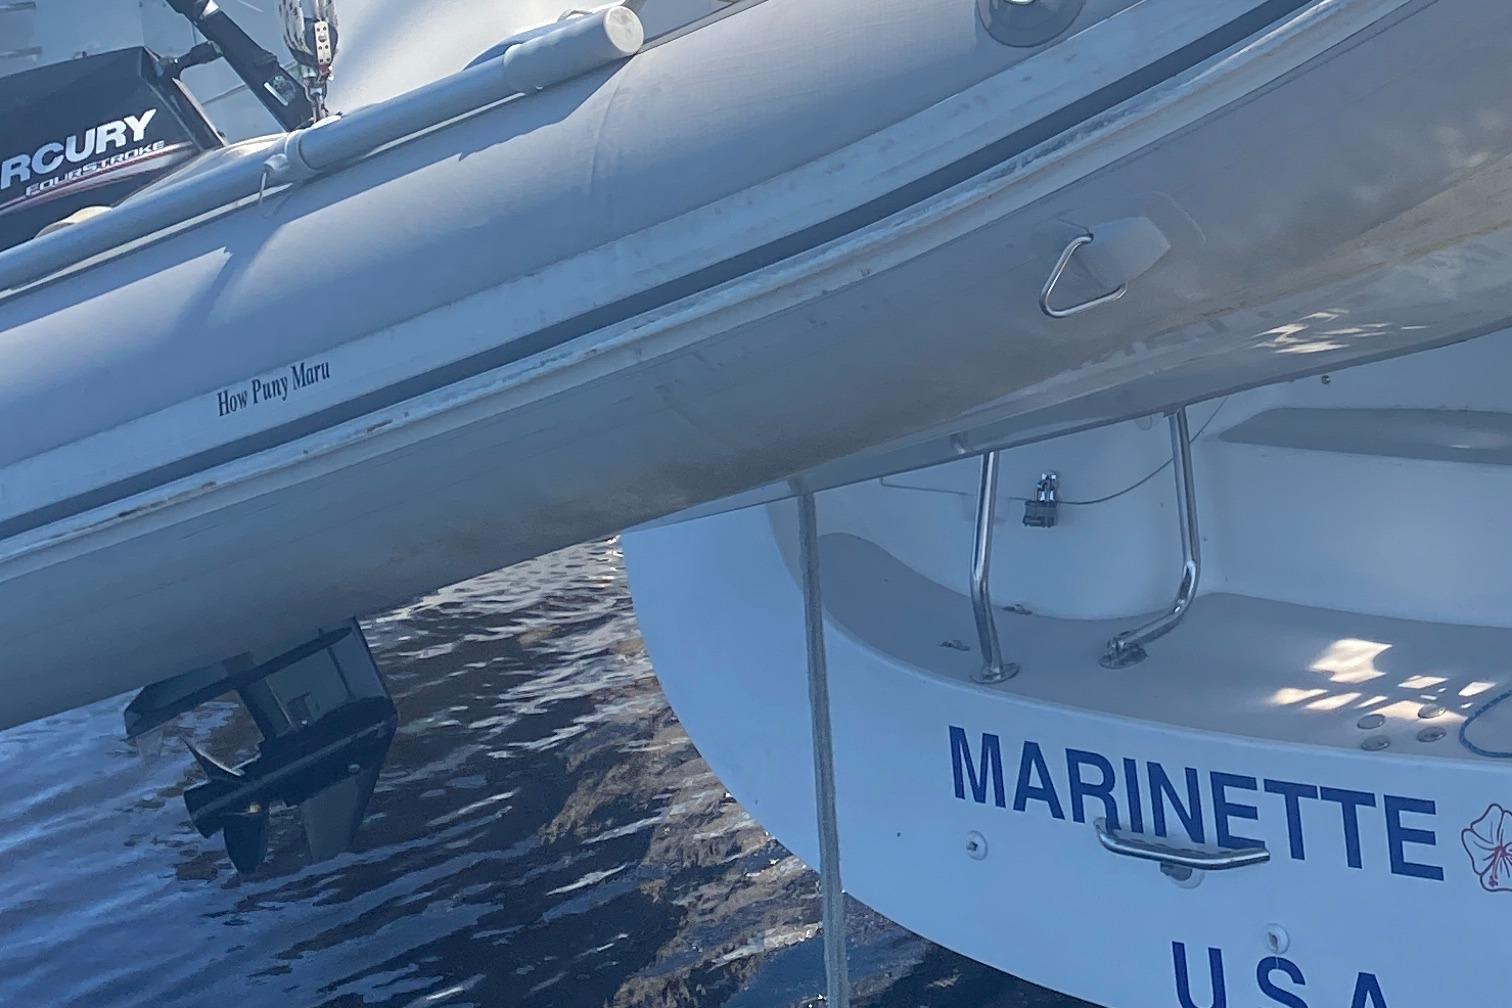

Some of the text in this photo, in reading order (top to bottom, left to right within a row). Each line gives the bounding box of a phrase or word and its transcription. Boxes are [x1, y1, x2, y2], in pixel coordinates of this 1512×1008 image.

[25, 140, 165, 197] FOURSTROKE
[217, 362, 331, 417] How Puny Maru
[948, 725, 1446, 881] MARINETTE
